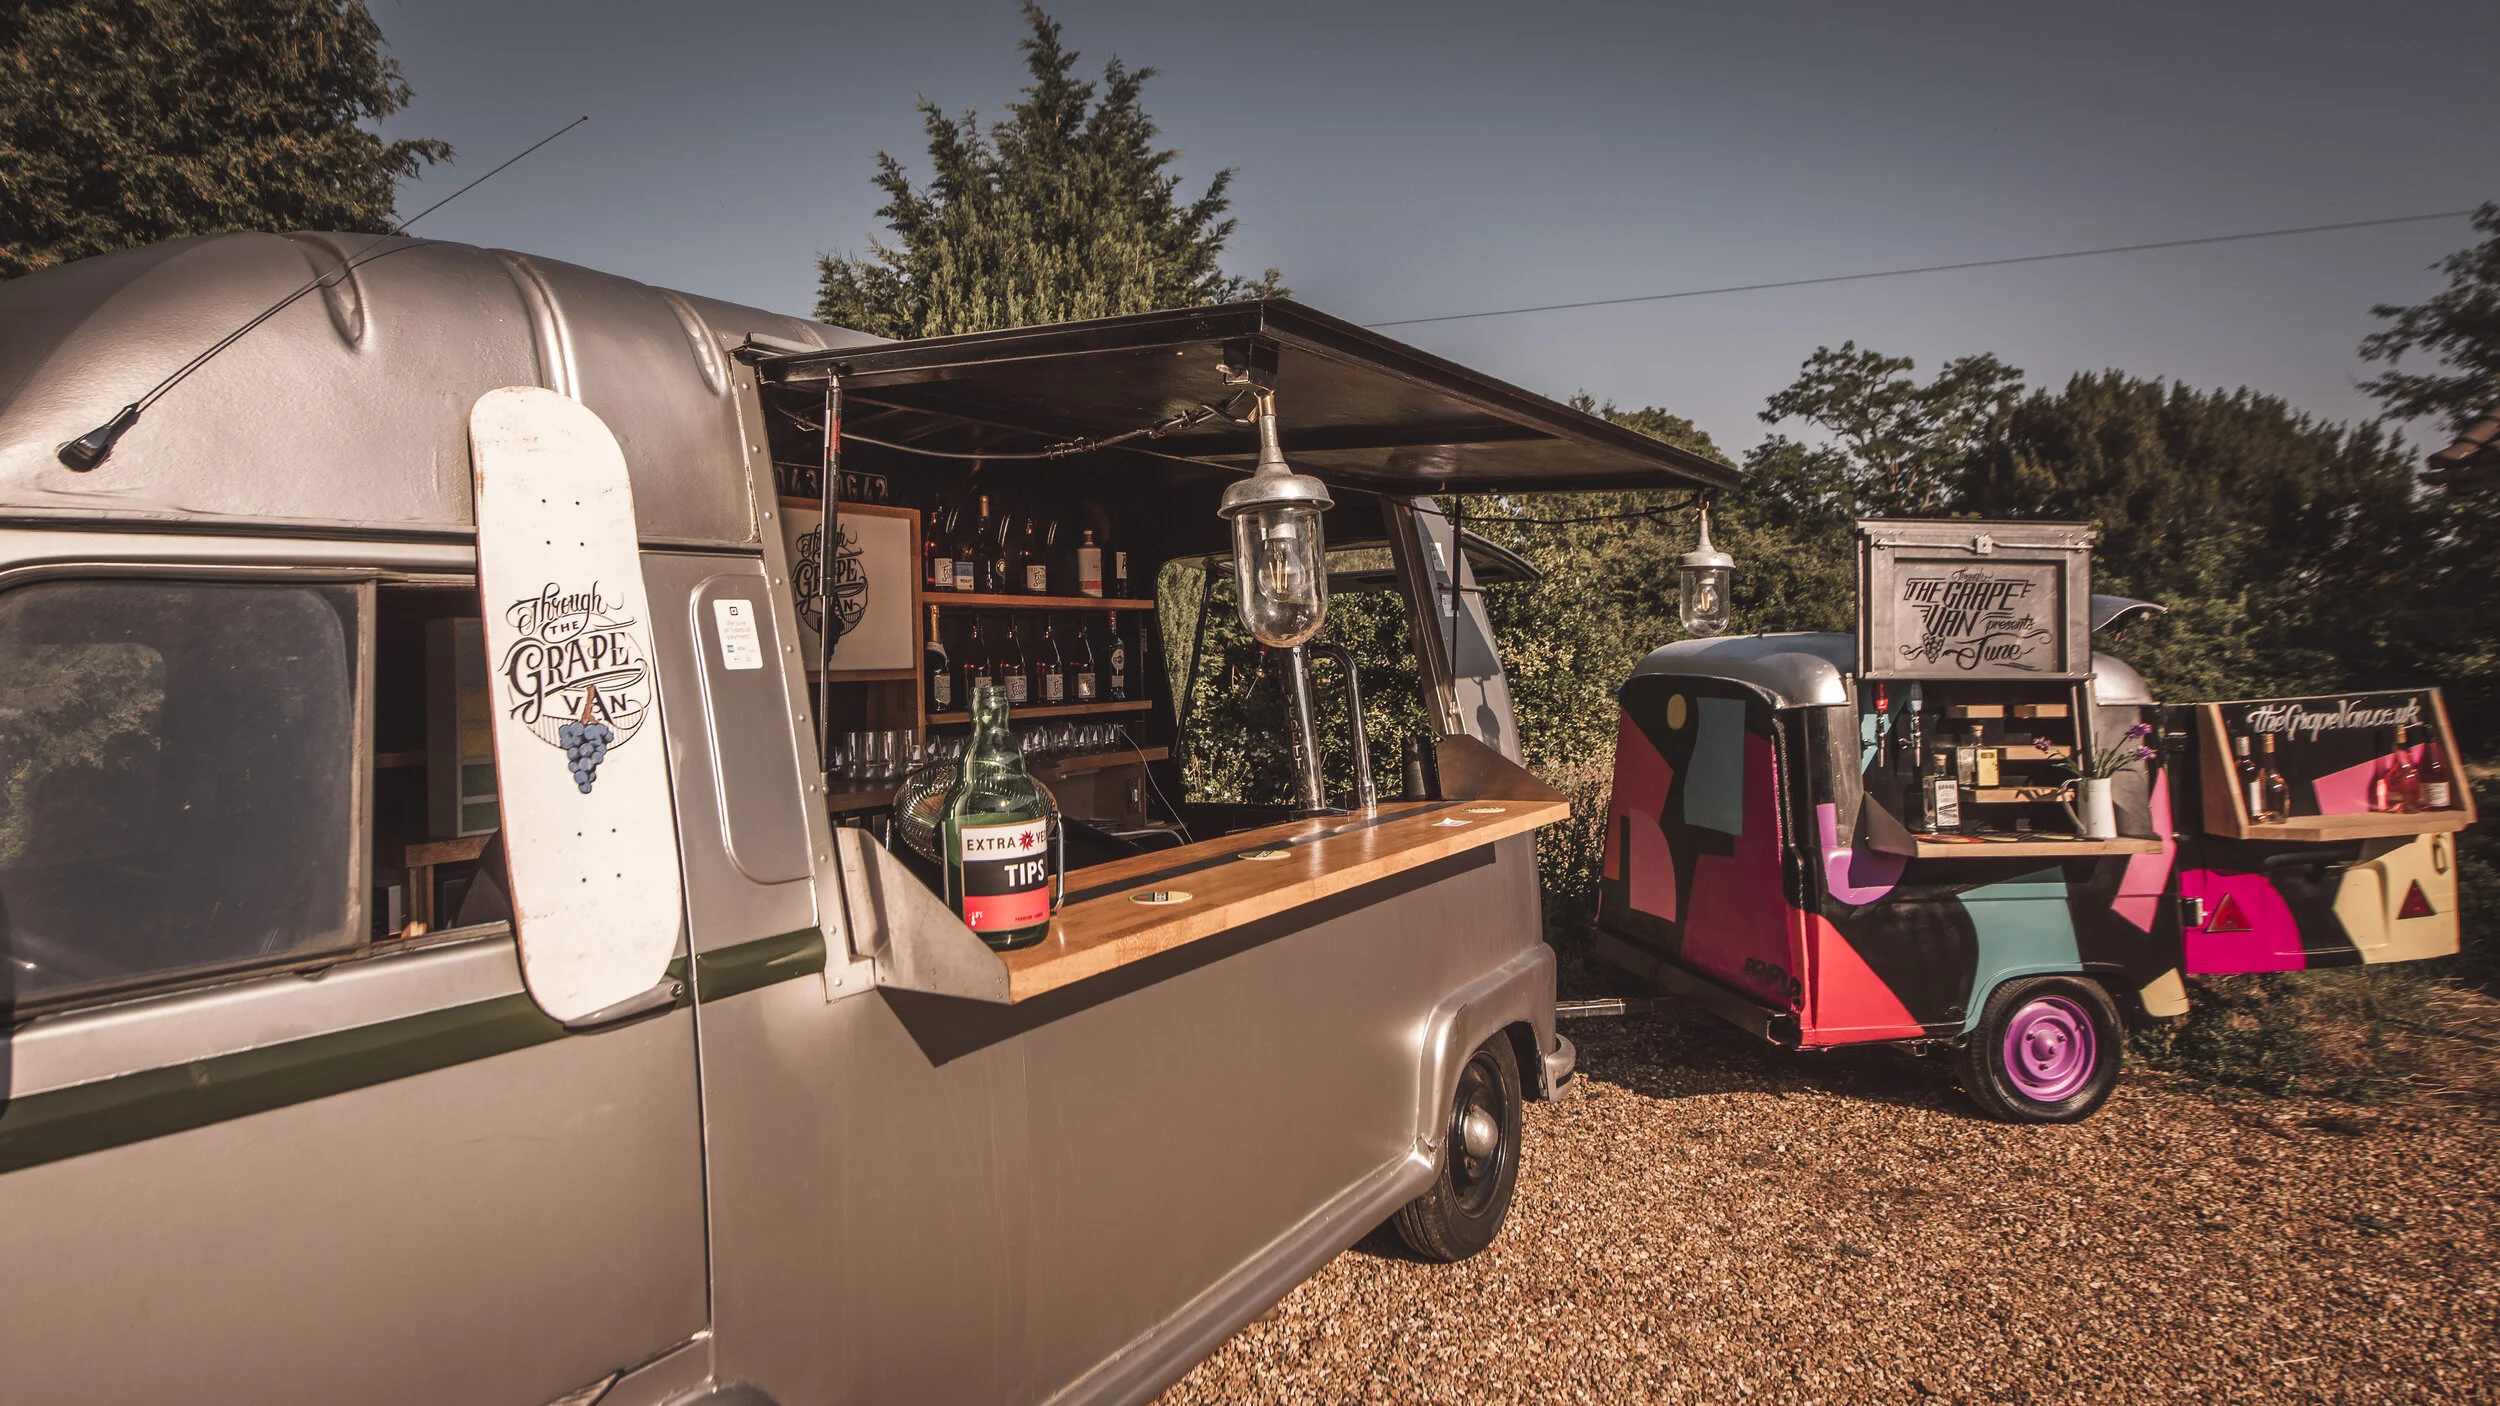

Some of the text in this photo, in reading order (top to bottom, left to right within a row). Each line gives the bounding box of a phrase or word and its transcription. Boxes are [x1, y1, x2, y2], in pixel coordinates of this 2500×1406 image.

[793, 559, 858, 615] GPE
[1903, 578, 2035, 611] THE GRAPE
[506, 581, 624, 636] Through
[1912, 604, 2036, 637] VAN presents
[549, 619, 580, 635] THE
[1955, 633, 2025, 671] June
[504, 631, 630, 724] GRAPE
[563, 686, 628, 723] VAN
[967, 837, 1016, 851] EXTRA
[1004, 858, 1045, 887] TIPS
